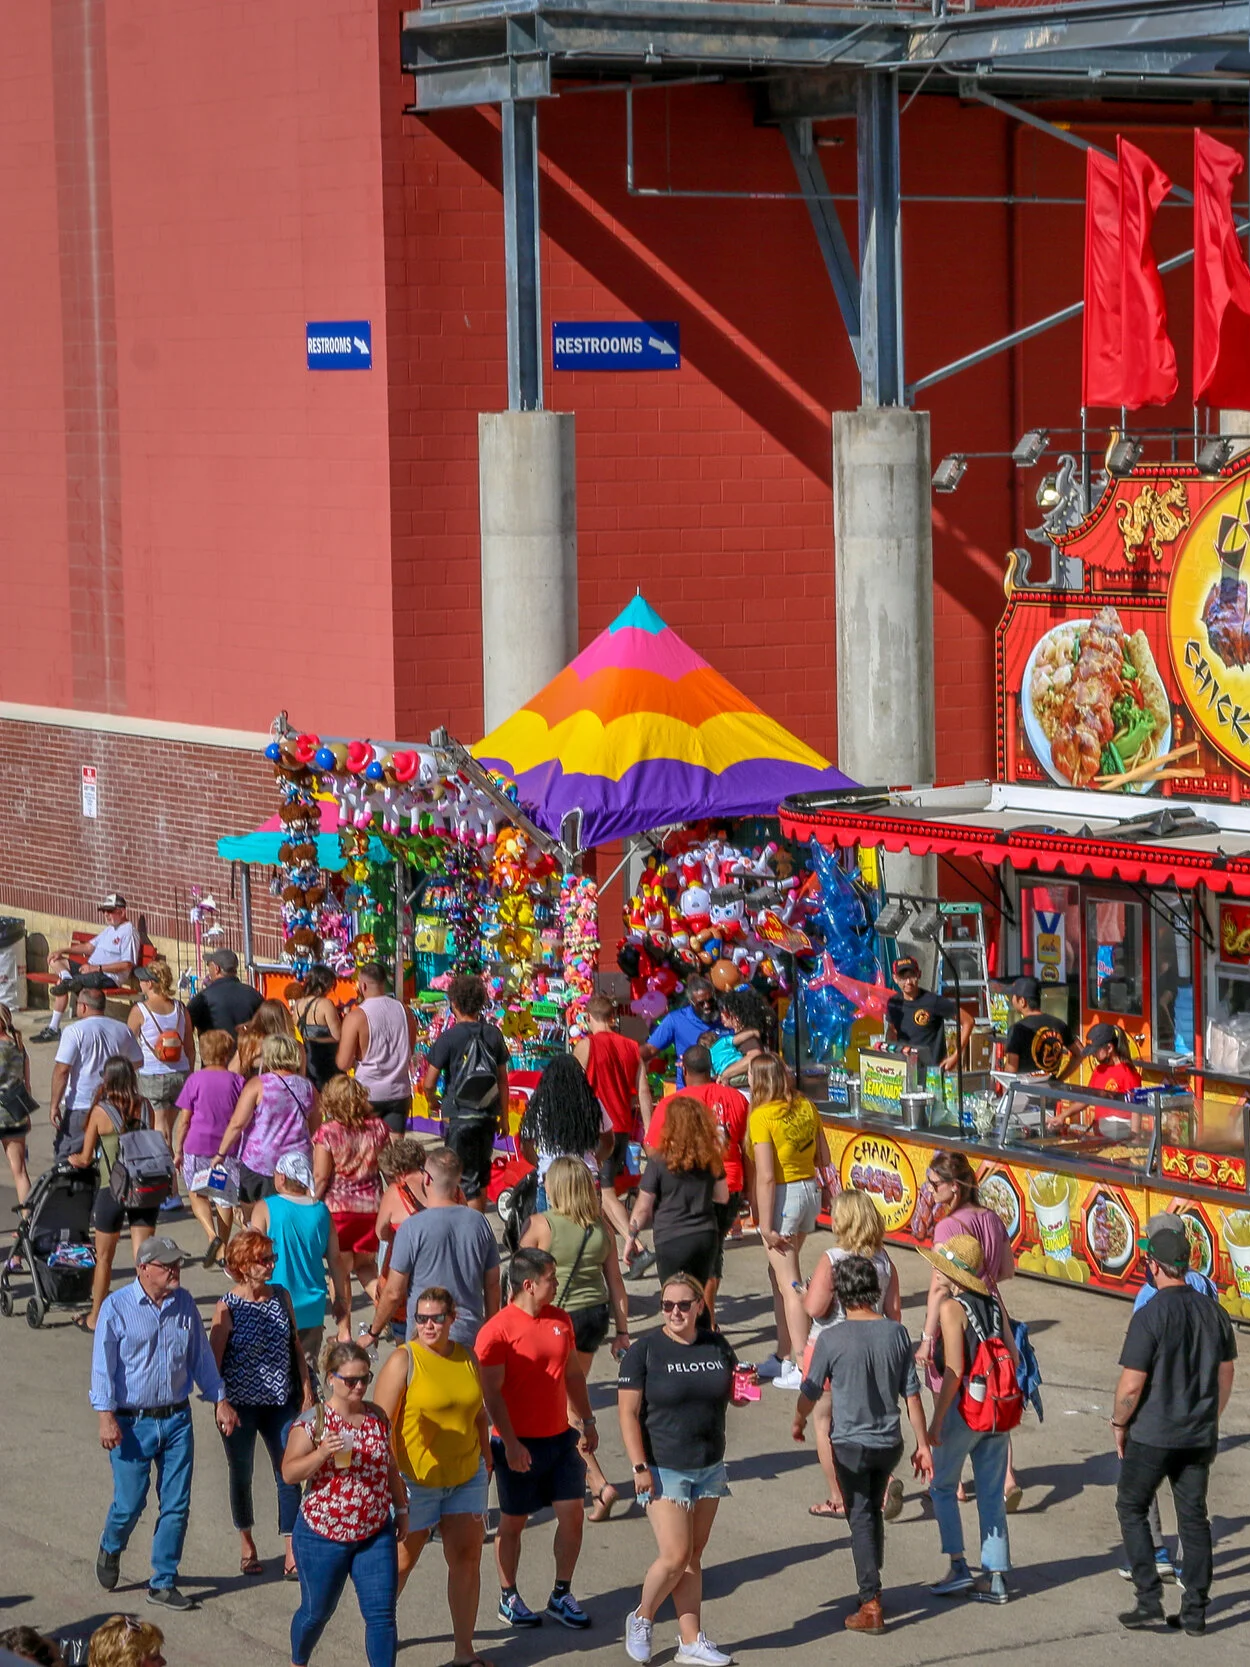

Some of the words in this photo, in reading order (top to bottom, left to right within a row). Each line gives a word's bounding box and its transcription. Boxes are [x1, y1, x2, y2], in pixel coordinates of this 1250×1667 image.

[307, 336, 351, 355] RESTROOMS
[555, 336, 643, 354] RESTROOMS
[864, 1080, 902, 1100] LEMONADE
[853, 1141, 900, 1170] CHAN'S
[667, 1360, 724, 1373] PELOTON
